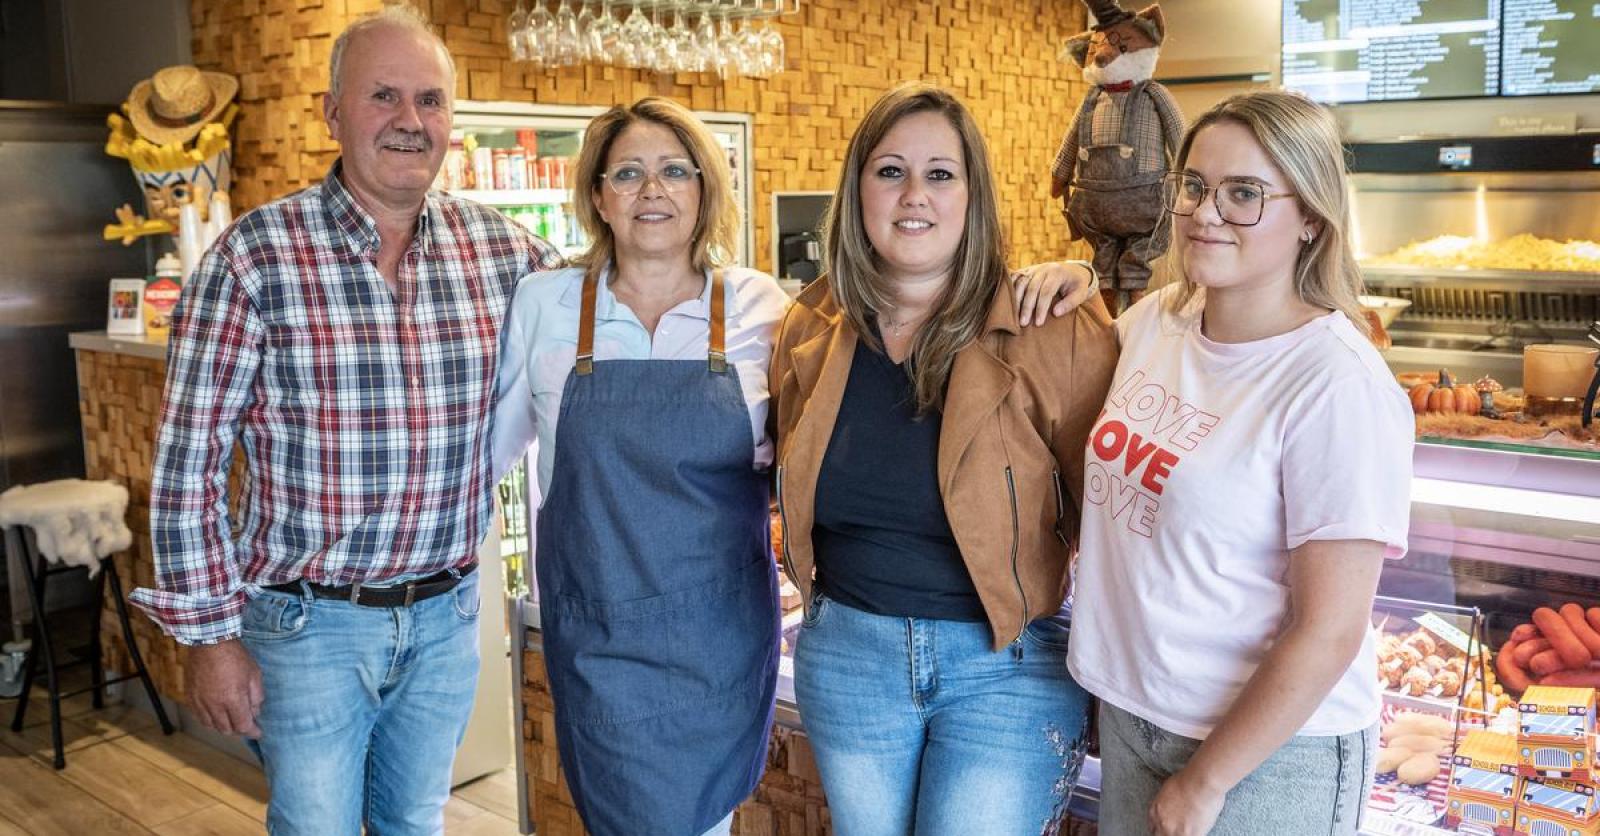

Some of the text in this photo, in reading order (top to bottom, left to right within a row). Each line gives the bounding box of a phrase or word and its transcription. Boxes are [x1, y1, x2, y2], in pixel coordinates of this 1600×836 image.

[1110, 370, 1221, 451] LOVE
[1086, 409, 1180, 496] OVE
[1085, 462, 1160, 538] OVE
